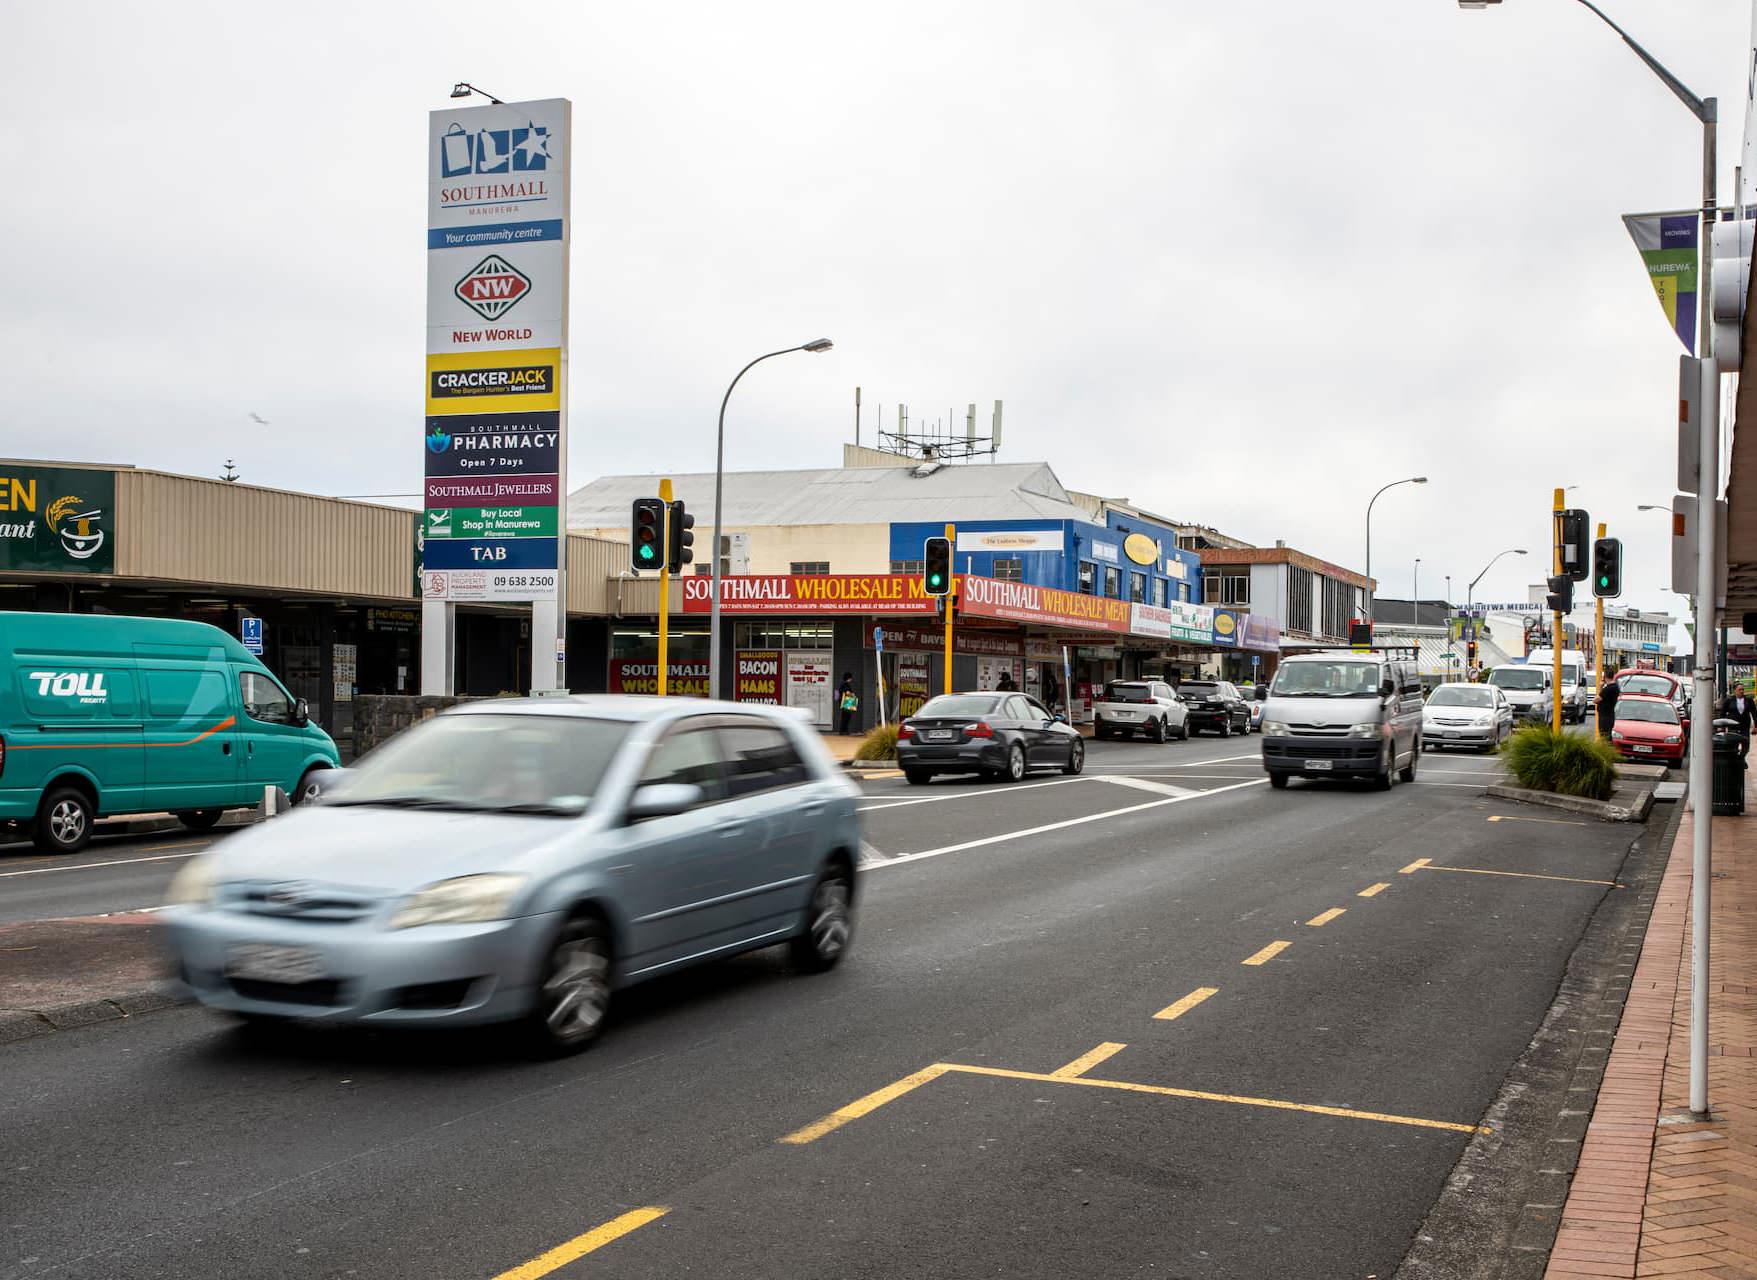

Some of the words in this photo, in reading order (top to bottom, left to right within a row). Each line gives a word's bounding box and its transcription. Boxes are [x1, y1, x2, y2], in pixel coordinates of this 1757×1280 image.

[441, 181, 548, 203] SOUTHMALL
[469, 205, 519, 215] MANUREWA
[445, 229, 465, 243] Your
[466, 228, 513, 243] community
[514, 227, 542, 238] centre
[1664, 229, 1691, 237] MOVING
[472, 277, 515, 299] NW
[452, 329, 482, 343] NEW
[485, 328, 532, 342] WORLD
[438, 369, 546, 387] CRACKERJACK
[471, 424, 541, 432] SOUTHMALL
[454, 433, 557, 450] PHARMACY
[460, 458, 486, 468] Open
[489, 458, 496, 466] 7
[500, 458, 523, 467] Days
[429, 484, 493, 497] SOUTHMALL
[494, 483, 552, 497] JEWELLERS
[481, 509, 496, 519] Buy
[499, 508, 522, 517] Local
[462, 520, 483, 531] Shop
[485, 520, 494, 529] in
[495, 519, 540, 529] Manurewa
[470, 546, 507, 560] TAB
[494, 576, 506, 586] 09
[508, 576, 527, 586] 638
[529, 576, 554, 586] 2500
[795, 578, 902, 599] WHOLESALE
[966, 577, 1040, 611] SOUTHMALL
[1043, 588, 1102, 619] WHOLESALE
[1104, 601, 1131, 623] MEAT
[1507, 602, 1543, 610] MEDICAL
[249, 620, 255, 629] P
[876, 630, 904, 642] PEN
[740, 660, 777, 675] BACON
[29, 671, 107, 696] TOLL
[621, 679, 710, 693] WHOESALE
[740, 680, 776, 694] HAMS
